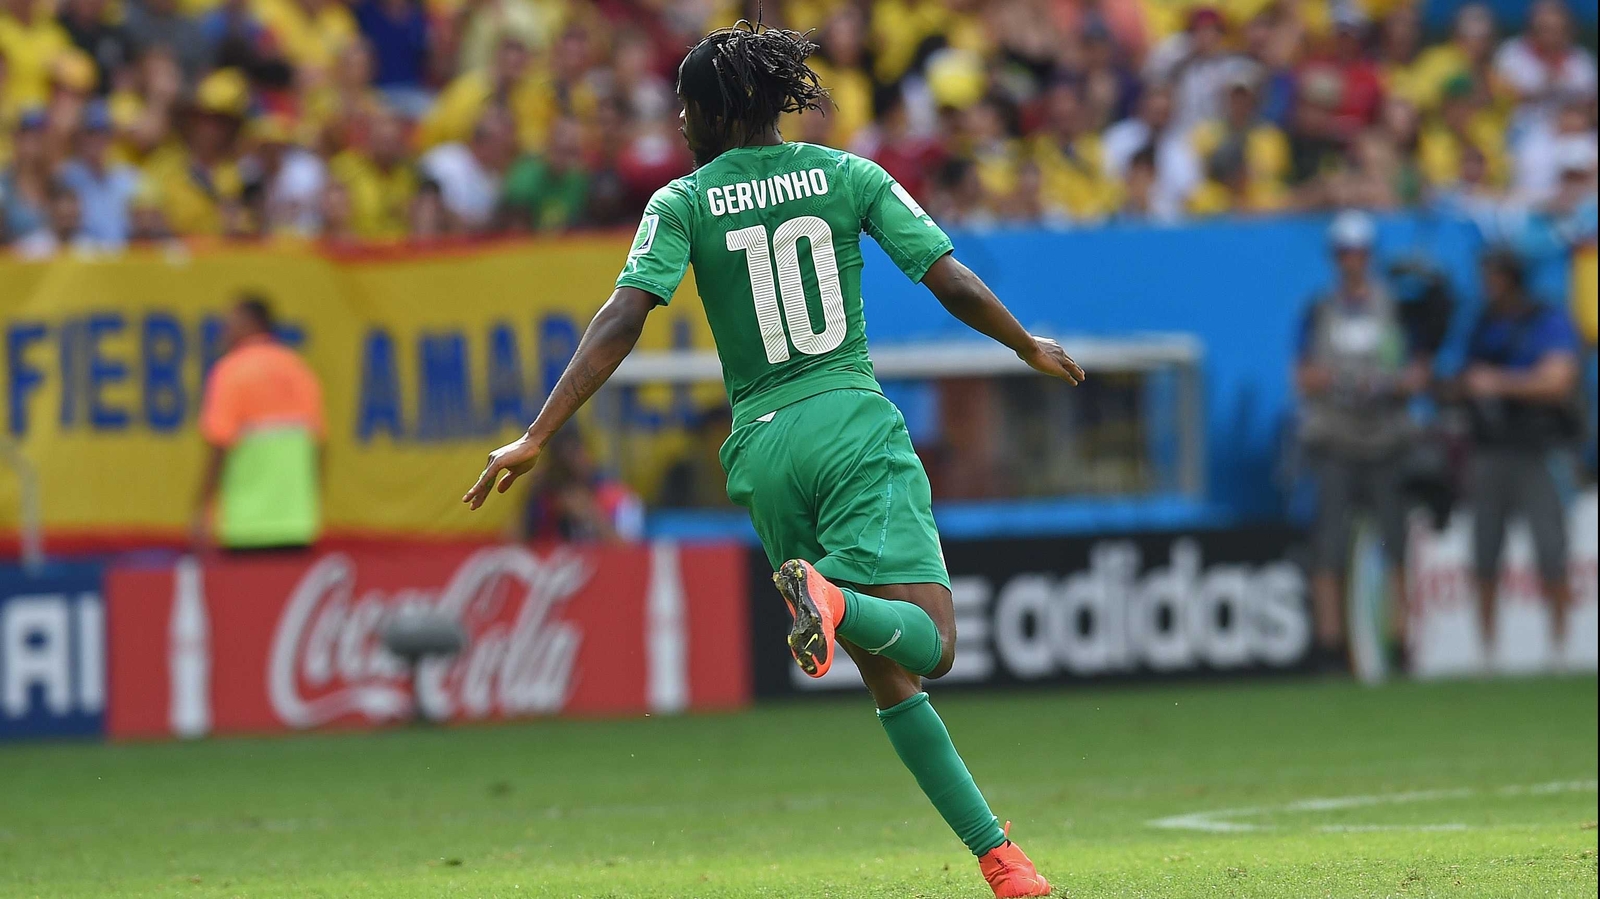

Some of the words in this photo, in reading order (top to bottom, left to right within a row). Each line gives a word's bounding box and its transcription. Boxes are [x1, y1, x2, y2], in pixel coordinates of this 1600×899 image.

[707, 168, 828, 216] GERVINHO
[726, 216, 847, 364] 10
[8, 310, 307, 437] FIEB
[267, 547, 596, 728] CocCola
[996, 539, 1311, 678] adidas
